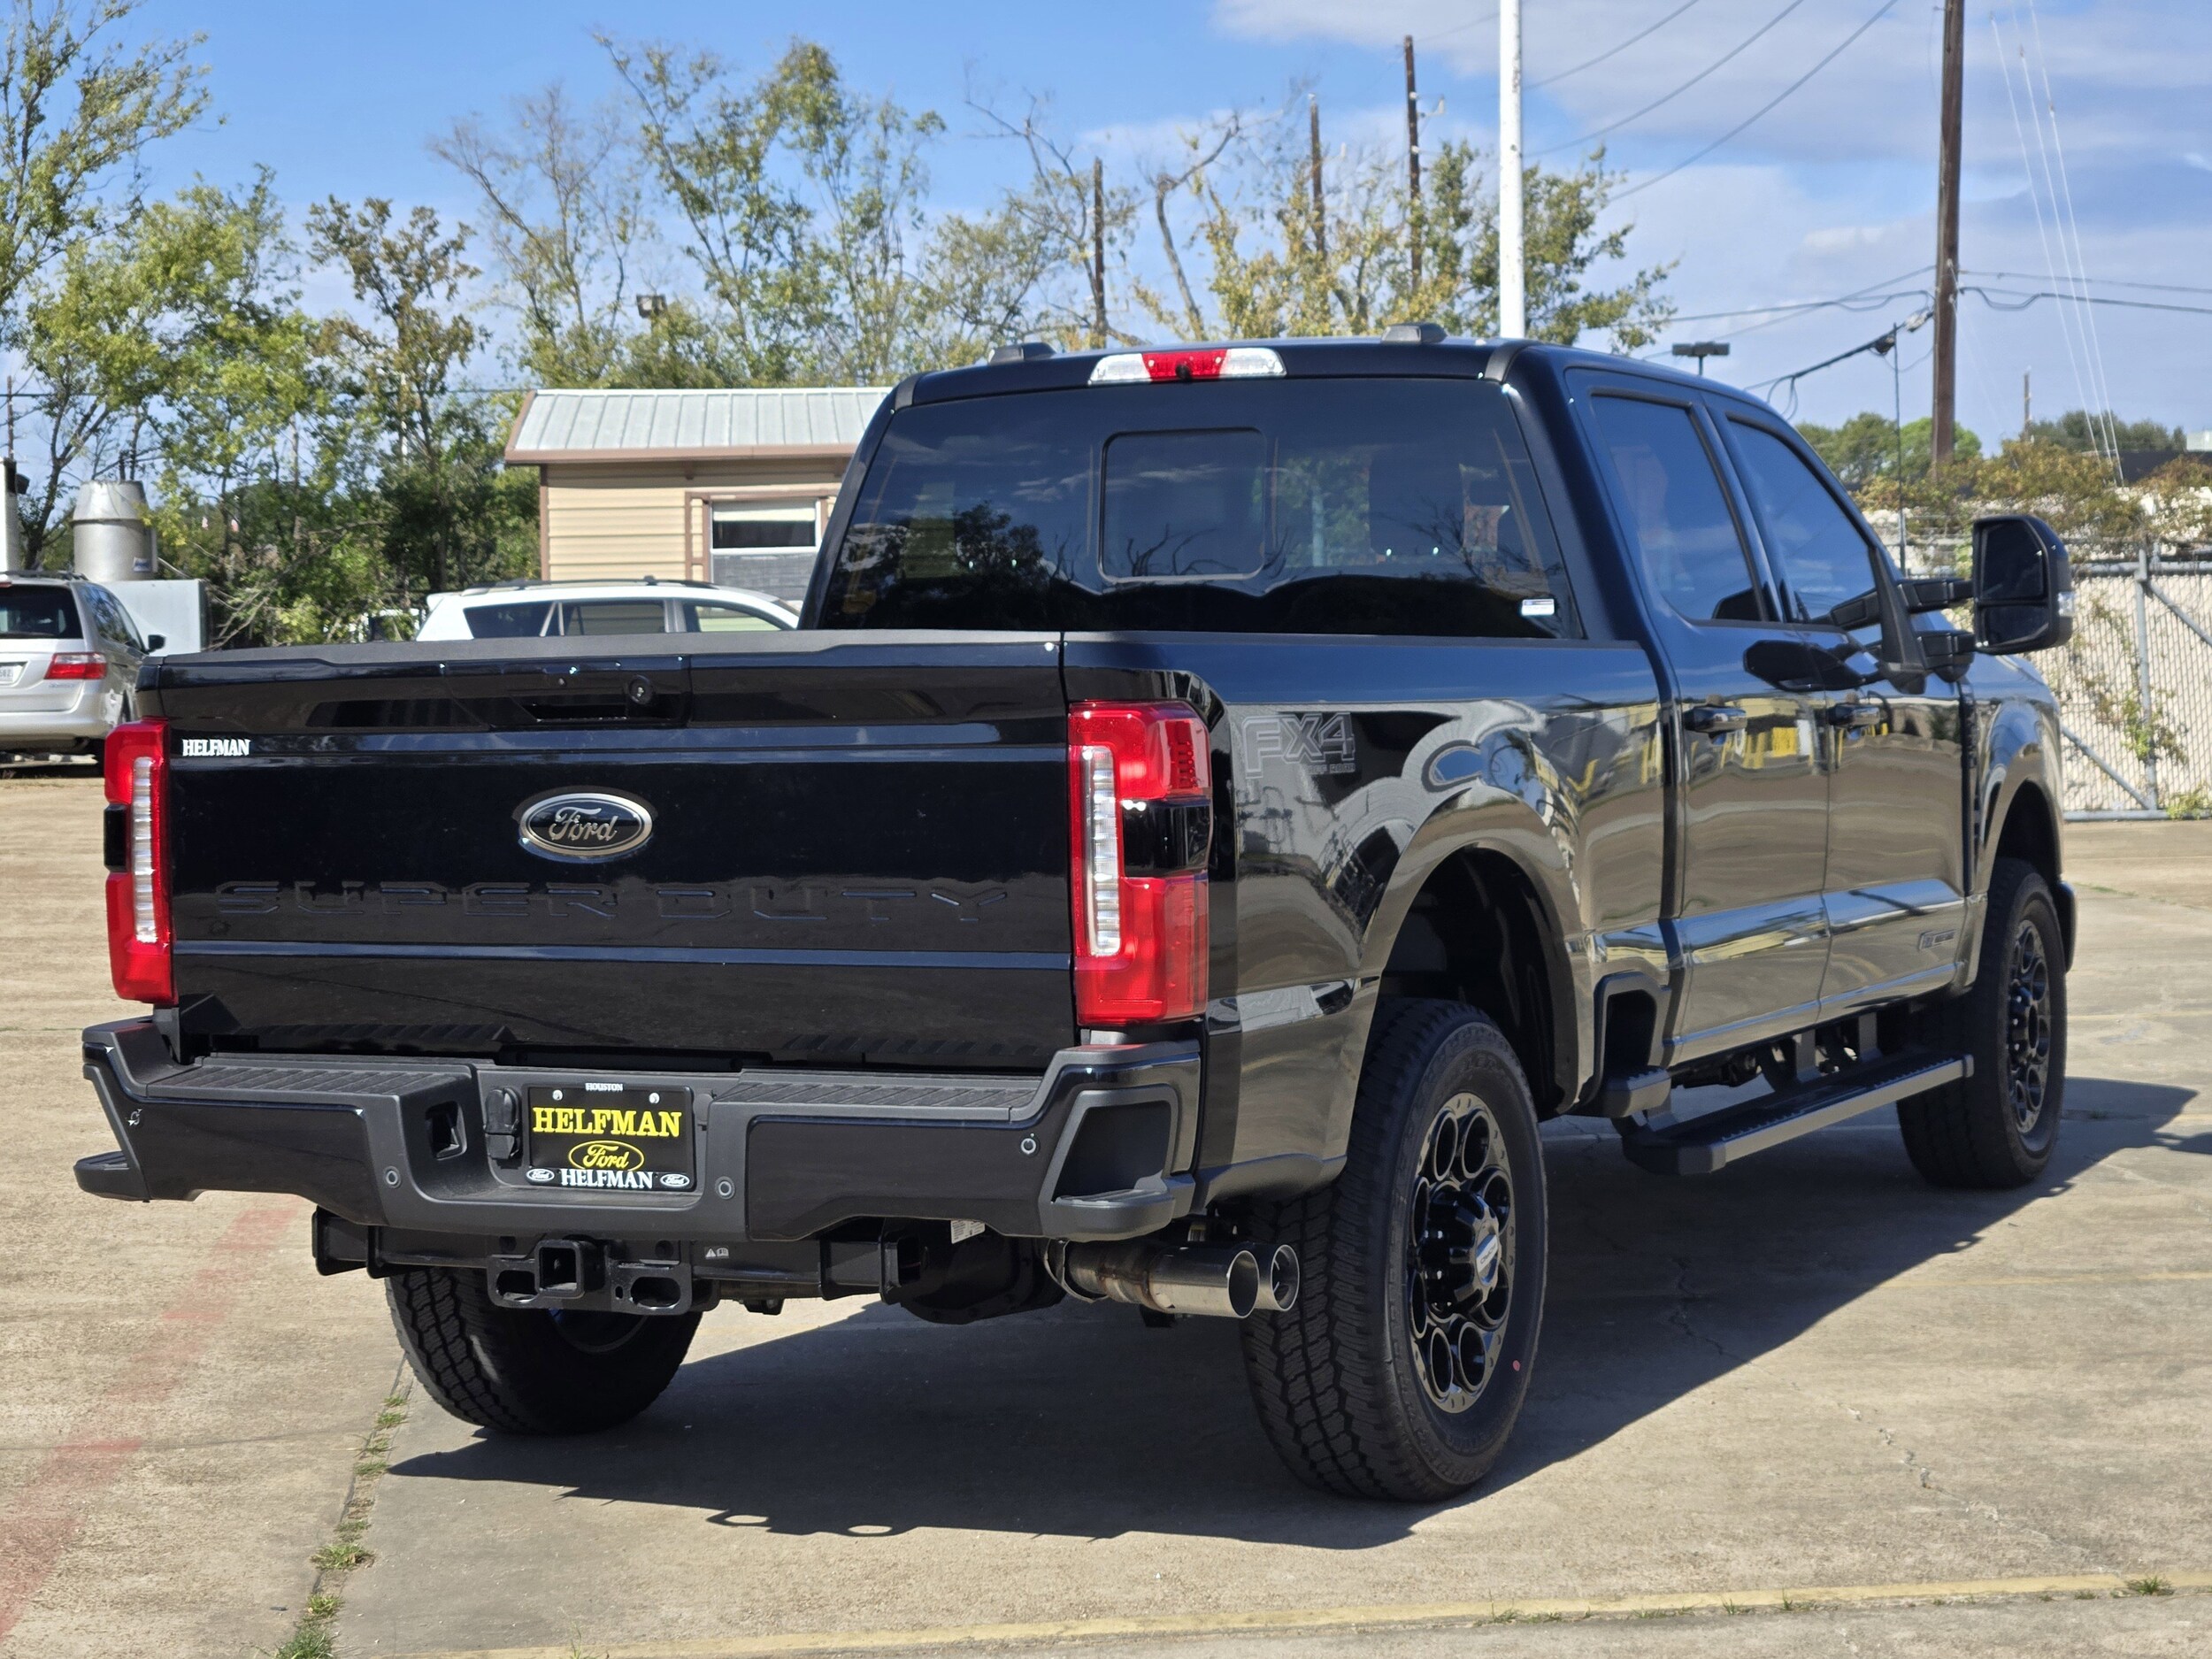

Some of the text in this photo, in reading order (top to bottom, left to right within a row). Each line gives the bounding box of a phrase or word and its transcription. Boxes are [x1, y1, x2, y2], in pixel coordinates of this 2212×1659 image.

[181, 739, 250, 757] HELFMAN
[1242, 712, 1356, 780] FX4
[549, 806, 618, 841] Ford
[216, 881, 1007, 921] SUPER DUTY
[585, 1082, 624, 1092] HOUSTON
[533, 1107, 682, 1137] HELFMAN
[582, 1144, 629, 1168] Ford
[561, 1168, 654, 1189] HELFMAN
